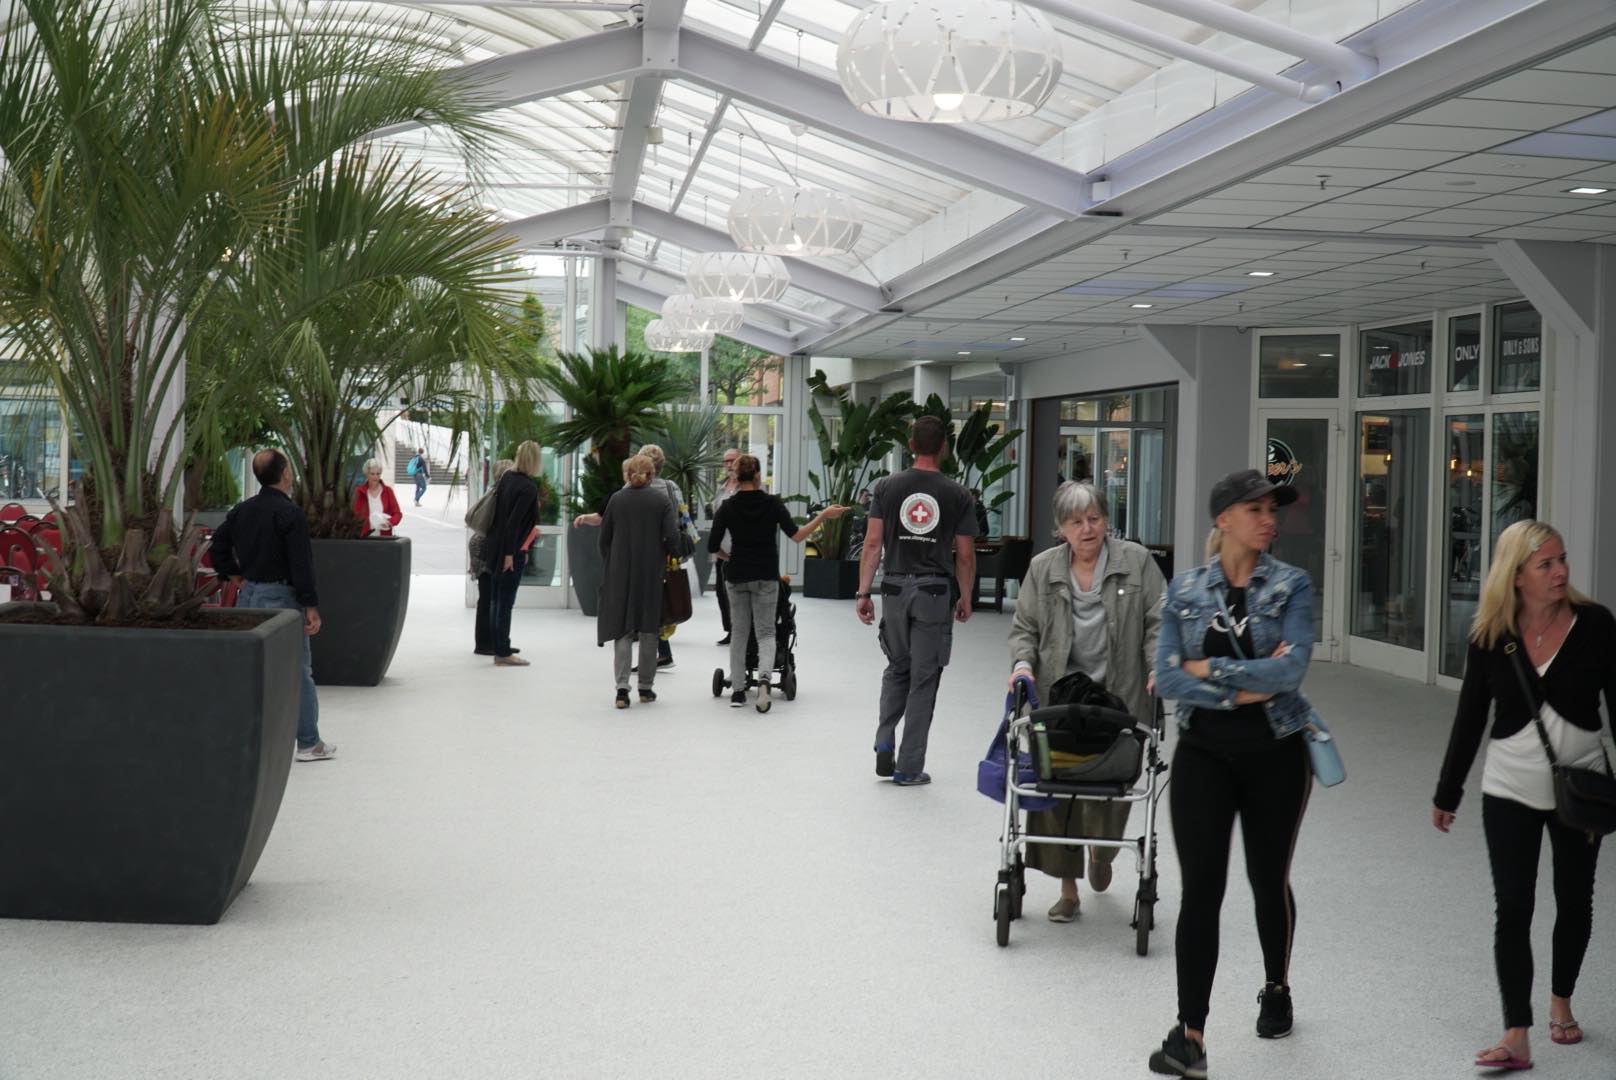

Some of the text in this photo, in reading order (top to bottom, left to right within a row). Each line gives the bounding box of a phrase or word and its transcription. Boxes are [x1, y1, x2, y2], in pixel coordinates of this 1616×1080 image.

[1455, 344, 1480, 362] ONLY
[1503, 339, 1518, 356] ONLY
[1523, 337, 1540, 354] SONS
[1369, 351, 1425, 369] JACK JONES
